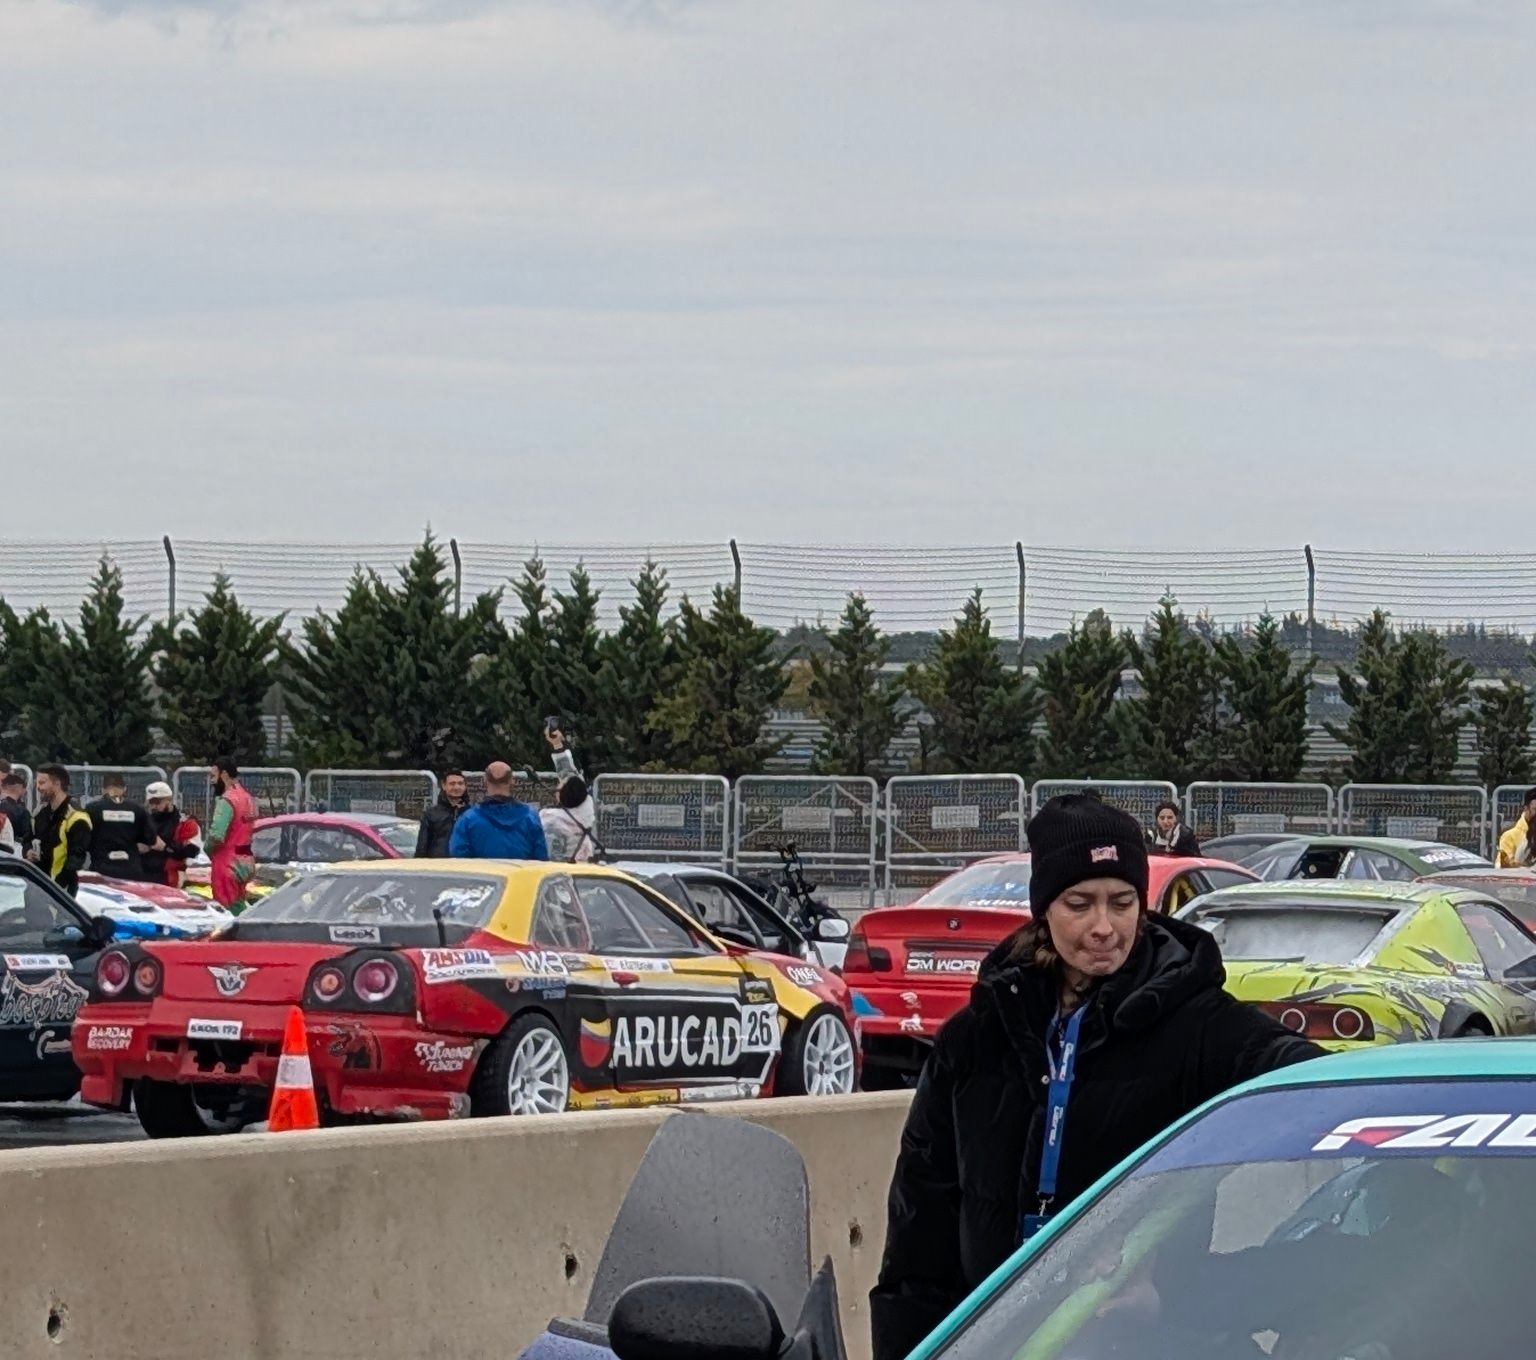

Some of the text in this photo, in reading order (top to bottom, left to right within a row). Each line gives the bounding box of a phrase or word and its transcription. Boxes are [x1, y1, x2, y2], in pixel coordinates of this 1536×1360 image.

[429, 950, 491, 968] AMSOIL
[612, 1016, 741, 1068] ARUCAD
[749, 1009, 771, 1046] 26
